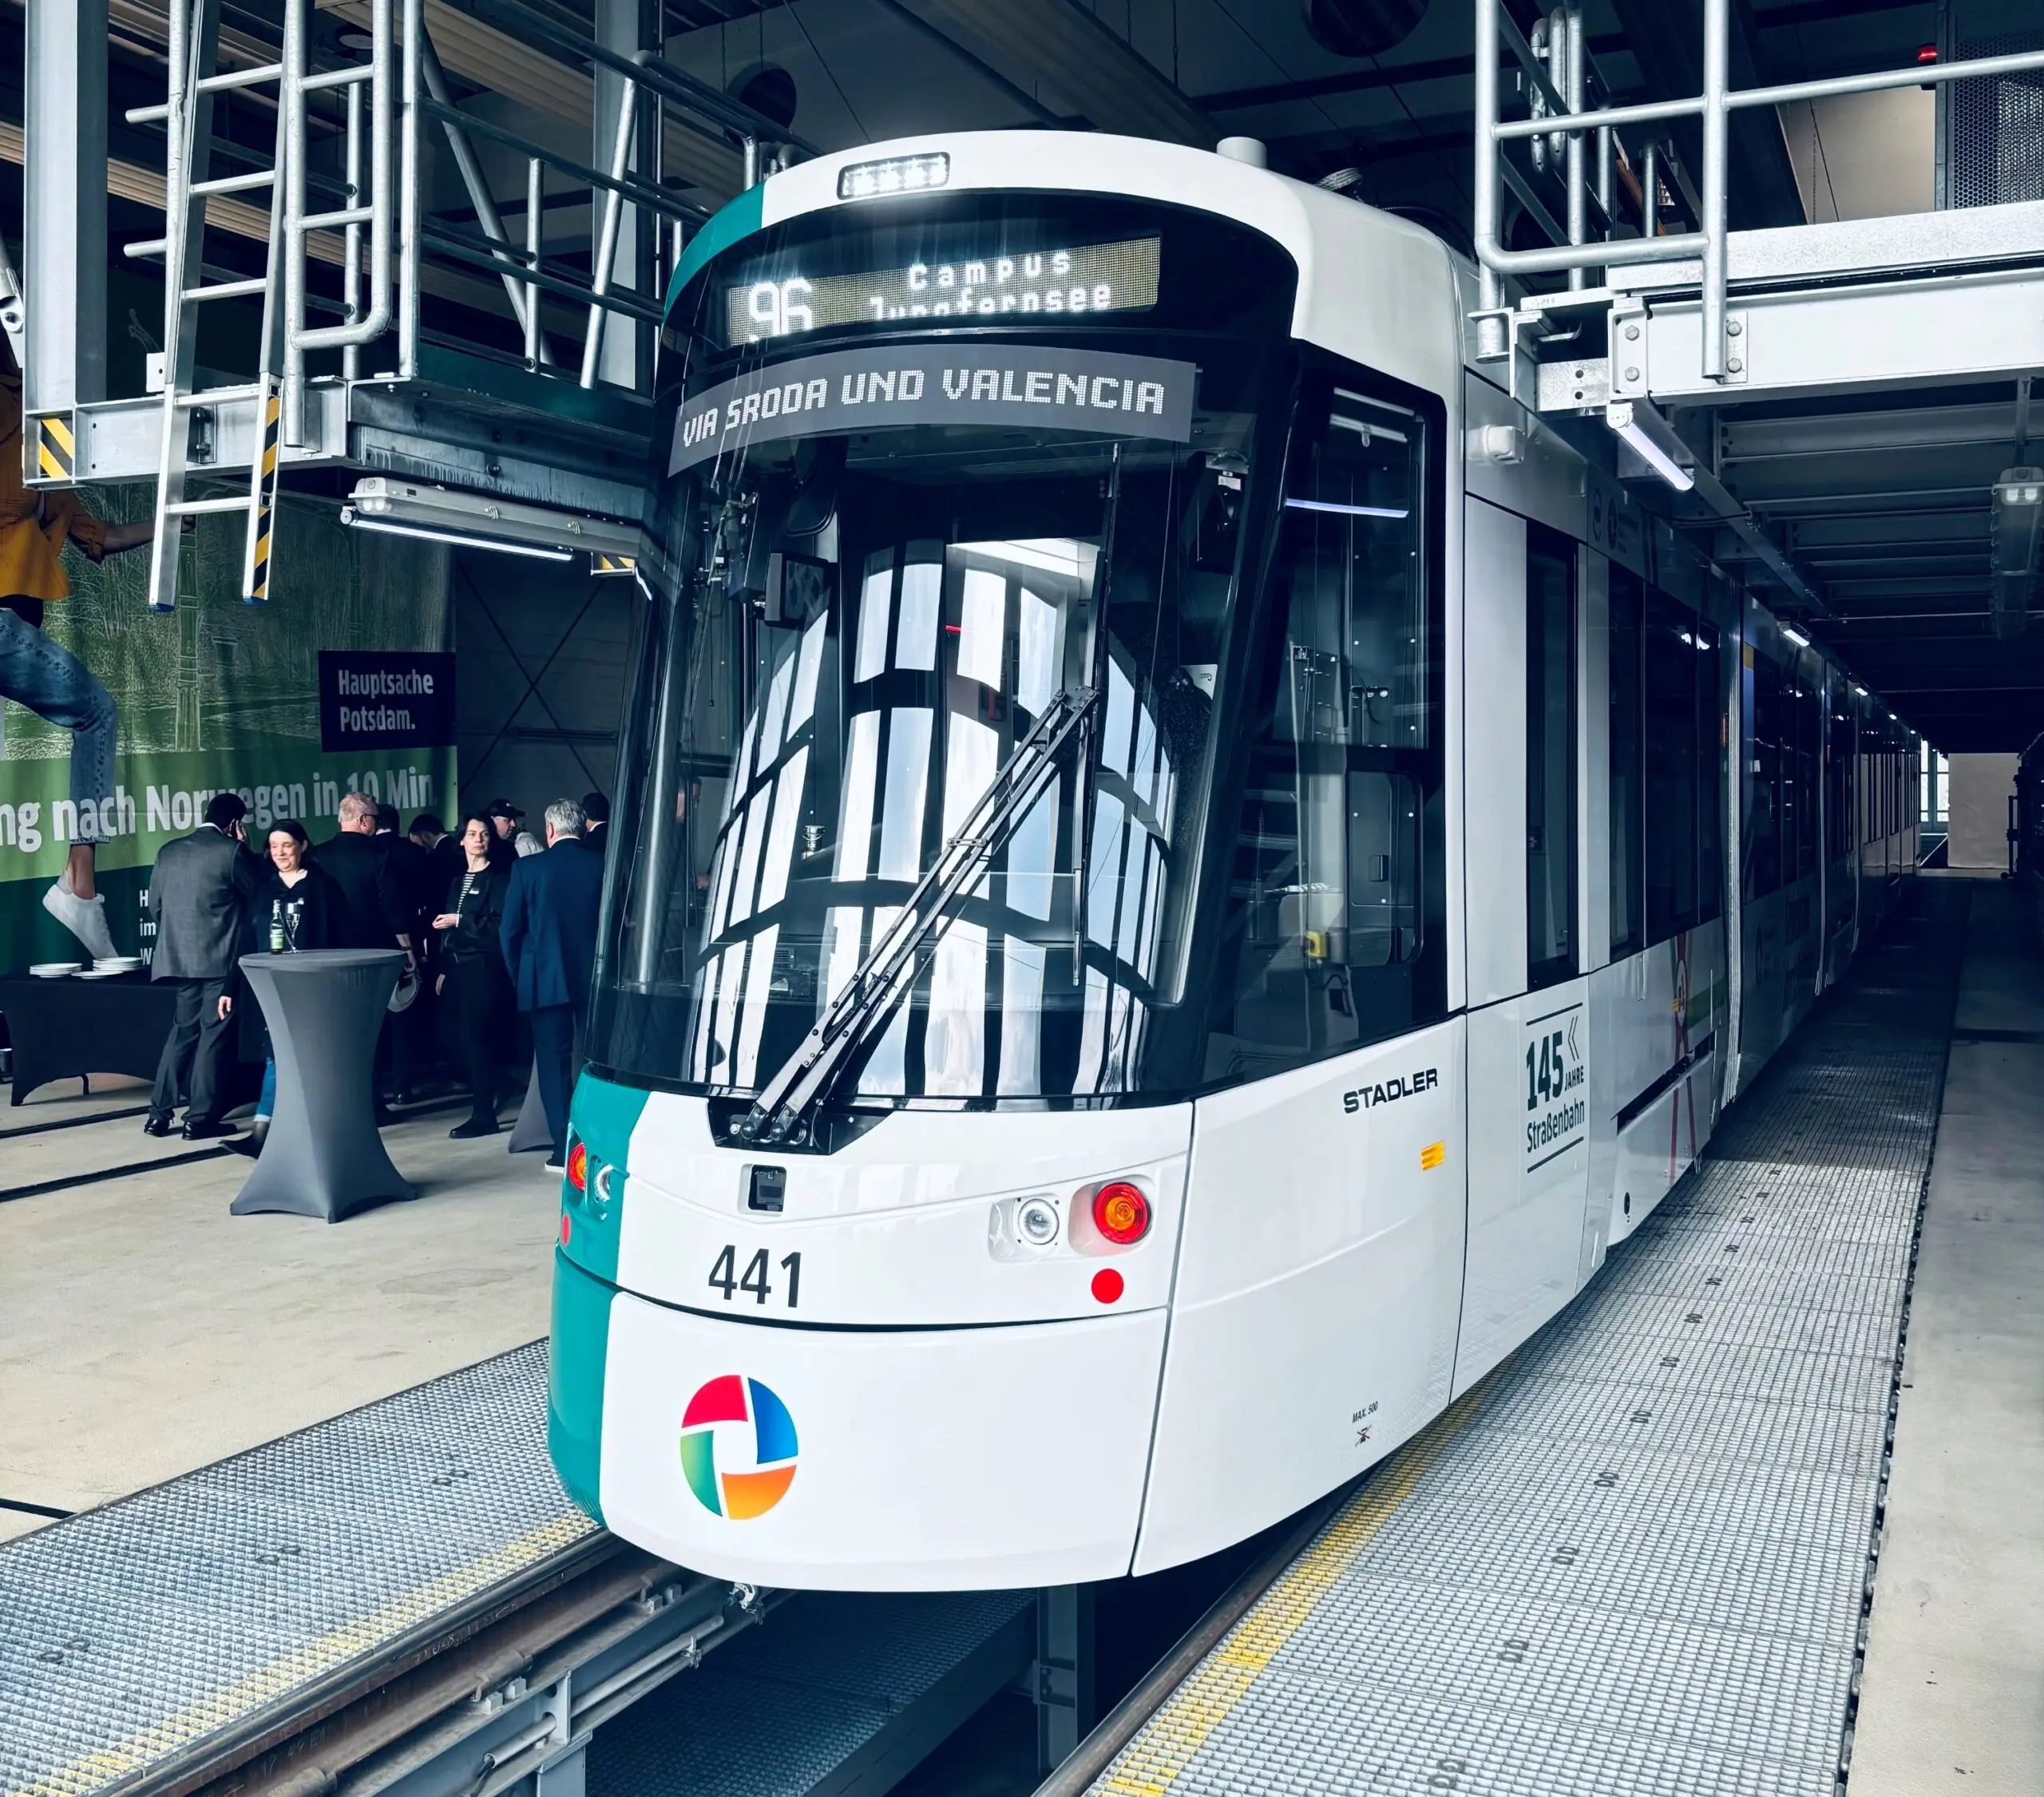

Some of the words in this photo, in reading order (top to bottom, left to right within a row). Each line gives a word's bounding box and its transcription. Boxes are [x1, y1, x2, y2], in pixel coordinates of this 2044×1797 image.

[909, 251, 1072, 291] Campus
[749, 276, 813, 343] 96
[683, 408, 719, 448] VIA
[725, 378, 827, 430] SRODA
[841, 370, 925, 406] UND
[942, 369, 1165, 415] VALENCIA
[338, 669, 434, 699] Hauptsache
[340, 704, 416, 732] Potsdam.
[53, 785, 136, 841] nach
[146, 782, 307, 832] Noregen
[313, 772, 339, 817] in
[1343, 1067, 1438, 1114] STADLER
[1526, 1030, 1563, 1111] 145
[1564, 1065, 1584, 1092] JAHRE
[1527, 1098, 1585, 1154] Straßenbahn
[708, 1244, 802, 1308] 441
